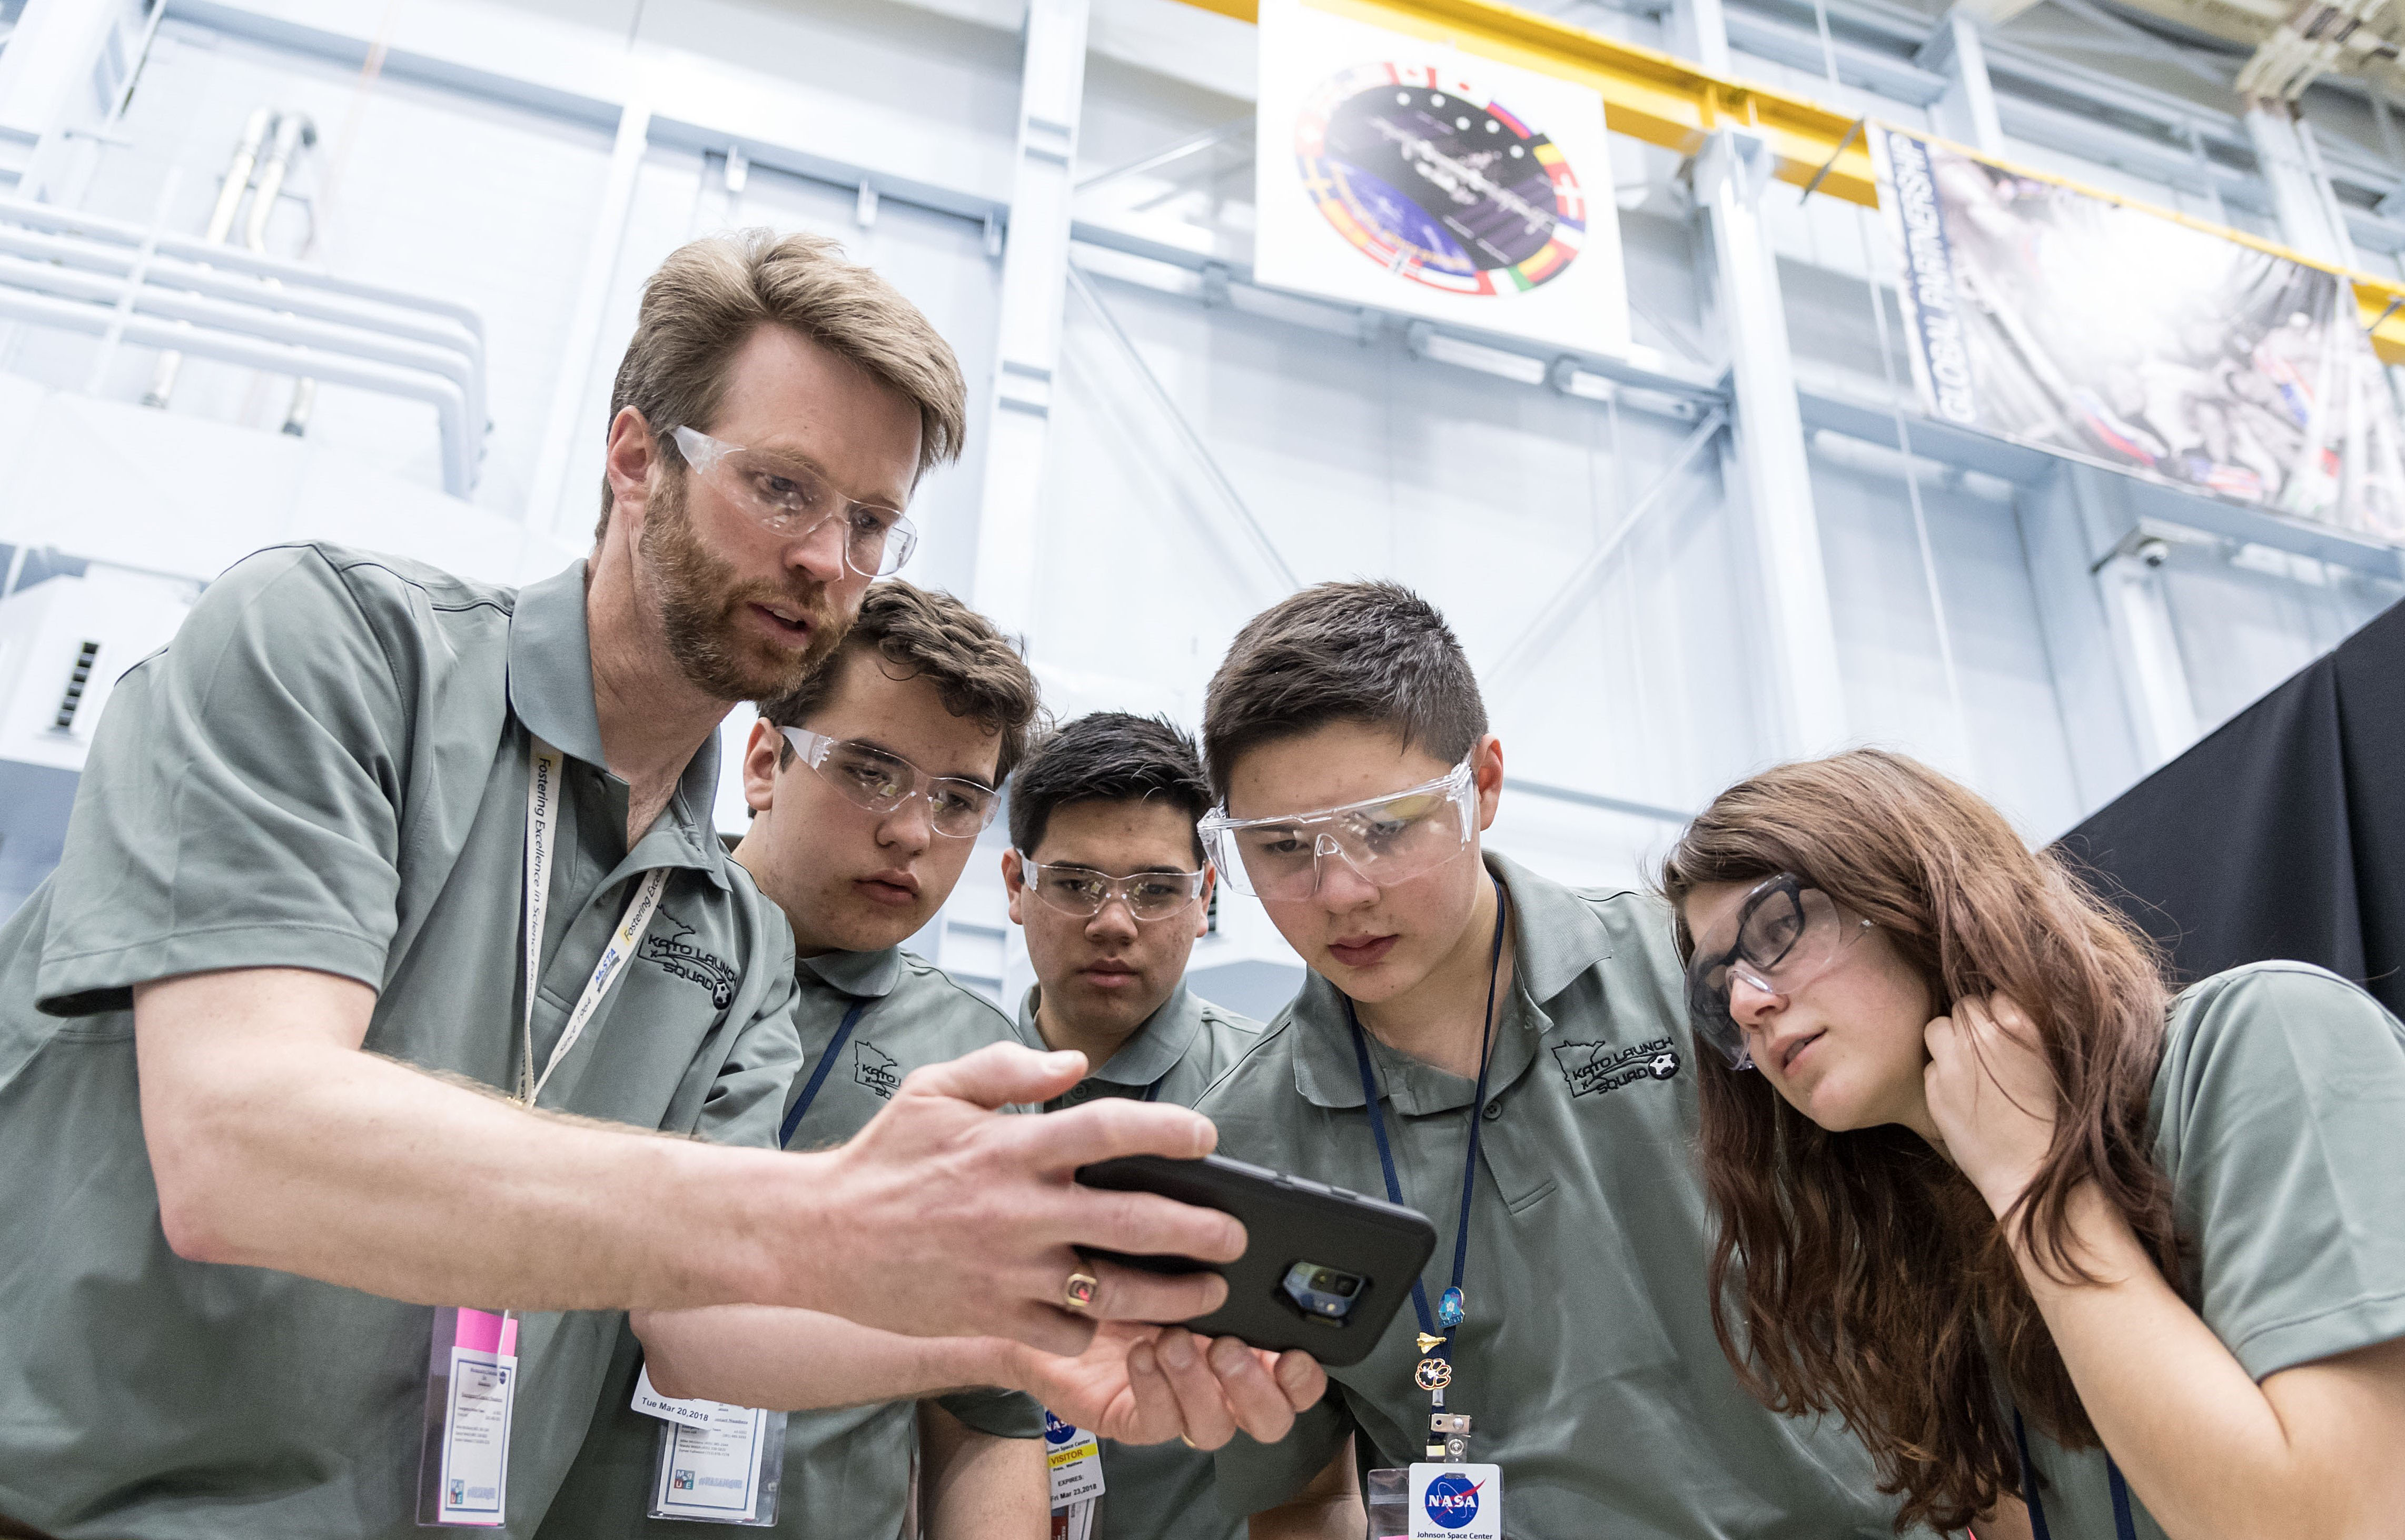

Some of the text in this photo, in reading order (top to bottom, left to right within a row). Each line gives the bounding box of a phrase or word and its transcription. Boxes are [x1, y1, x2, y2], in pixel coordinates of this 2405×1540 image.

[1889, 132, 1975, 422] GLOBAL PARTNERSHIP
[534, 757, 551, 818] Fostering
[534, 819, 546, 888] Excellence
[535, 890, 541, 902] in
[531, 905, 540, 957] Science
[624, 896, 651, 941] Fostering
[648, 934, 737, 987] KATO LAUNCH
[662, 962, 714, 991] SQUAD
[1572, 1036, 1674, 1080] KATO LAUNCH
[862, 1064, 895, 1084] KATO
[1596, 1068, 1648, 1095] SQUAD
[642, 1397, 708, 1421] Tue Mar 20,2018
[1051, 1448, 1083, 1465] VISITOR
[1073, 1483, 1097, 1496] 23,2018
[1429, 1495, 1477, 1507] NASA
